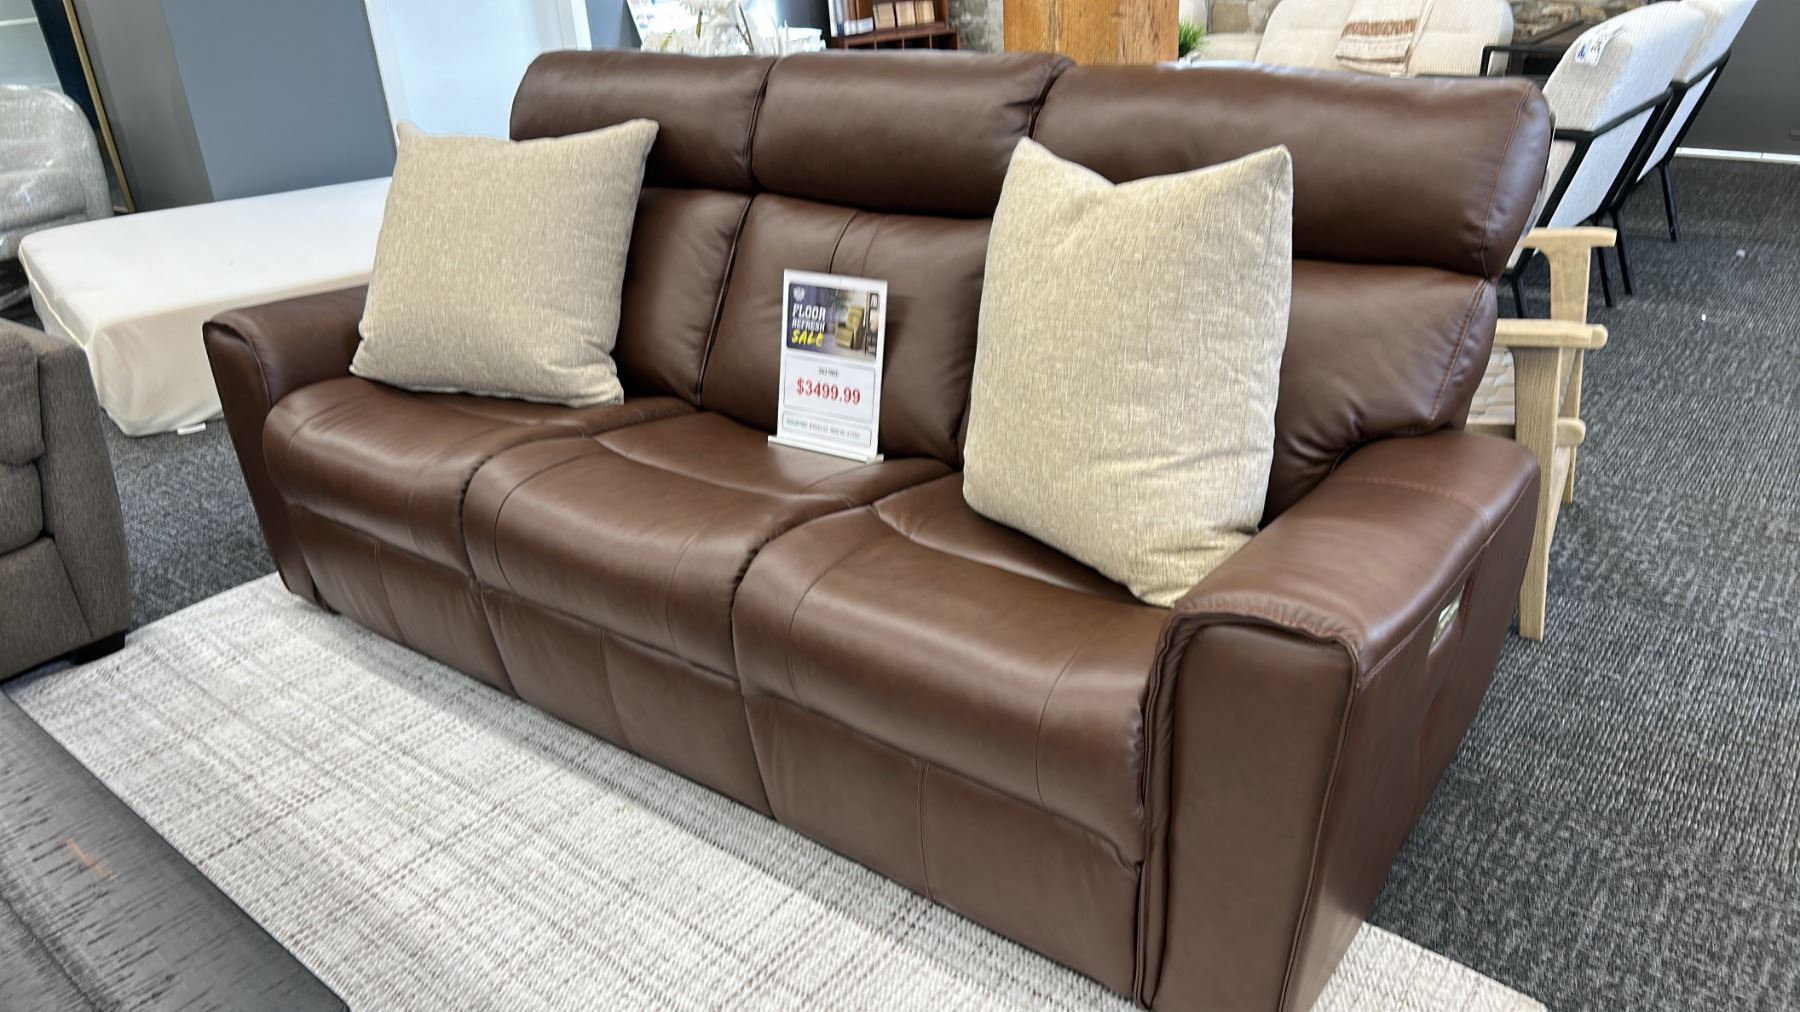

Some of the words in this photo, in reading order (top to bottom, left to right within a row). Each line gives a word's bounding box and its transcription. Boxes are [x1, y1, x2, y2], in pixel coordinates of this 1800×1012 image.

[792, 303, 826, 321] FLOOR
[792, 317, 825, 332] REFRESH
[791, 329, 824, 347] SALE
[796, 377, 861, 405] $3499.99
